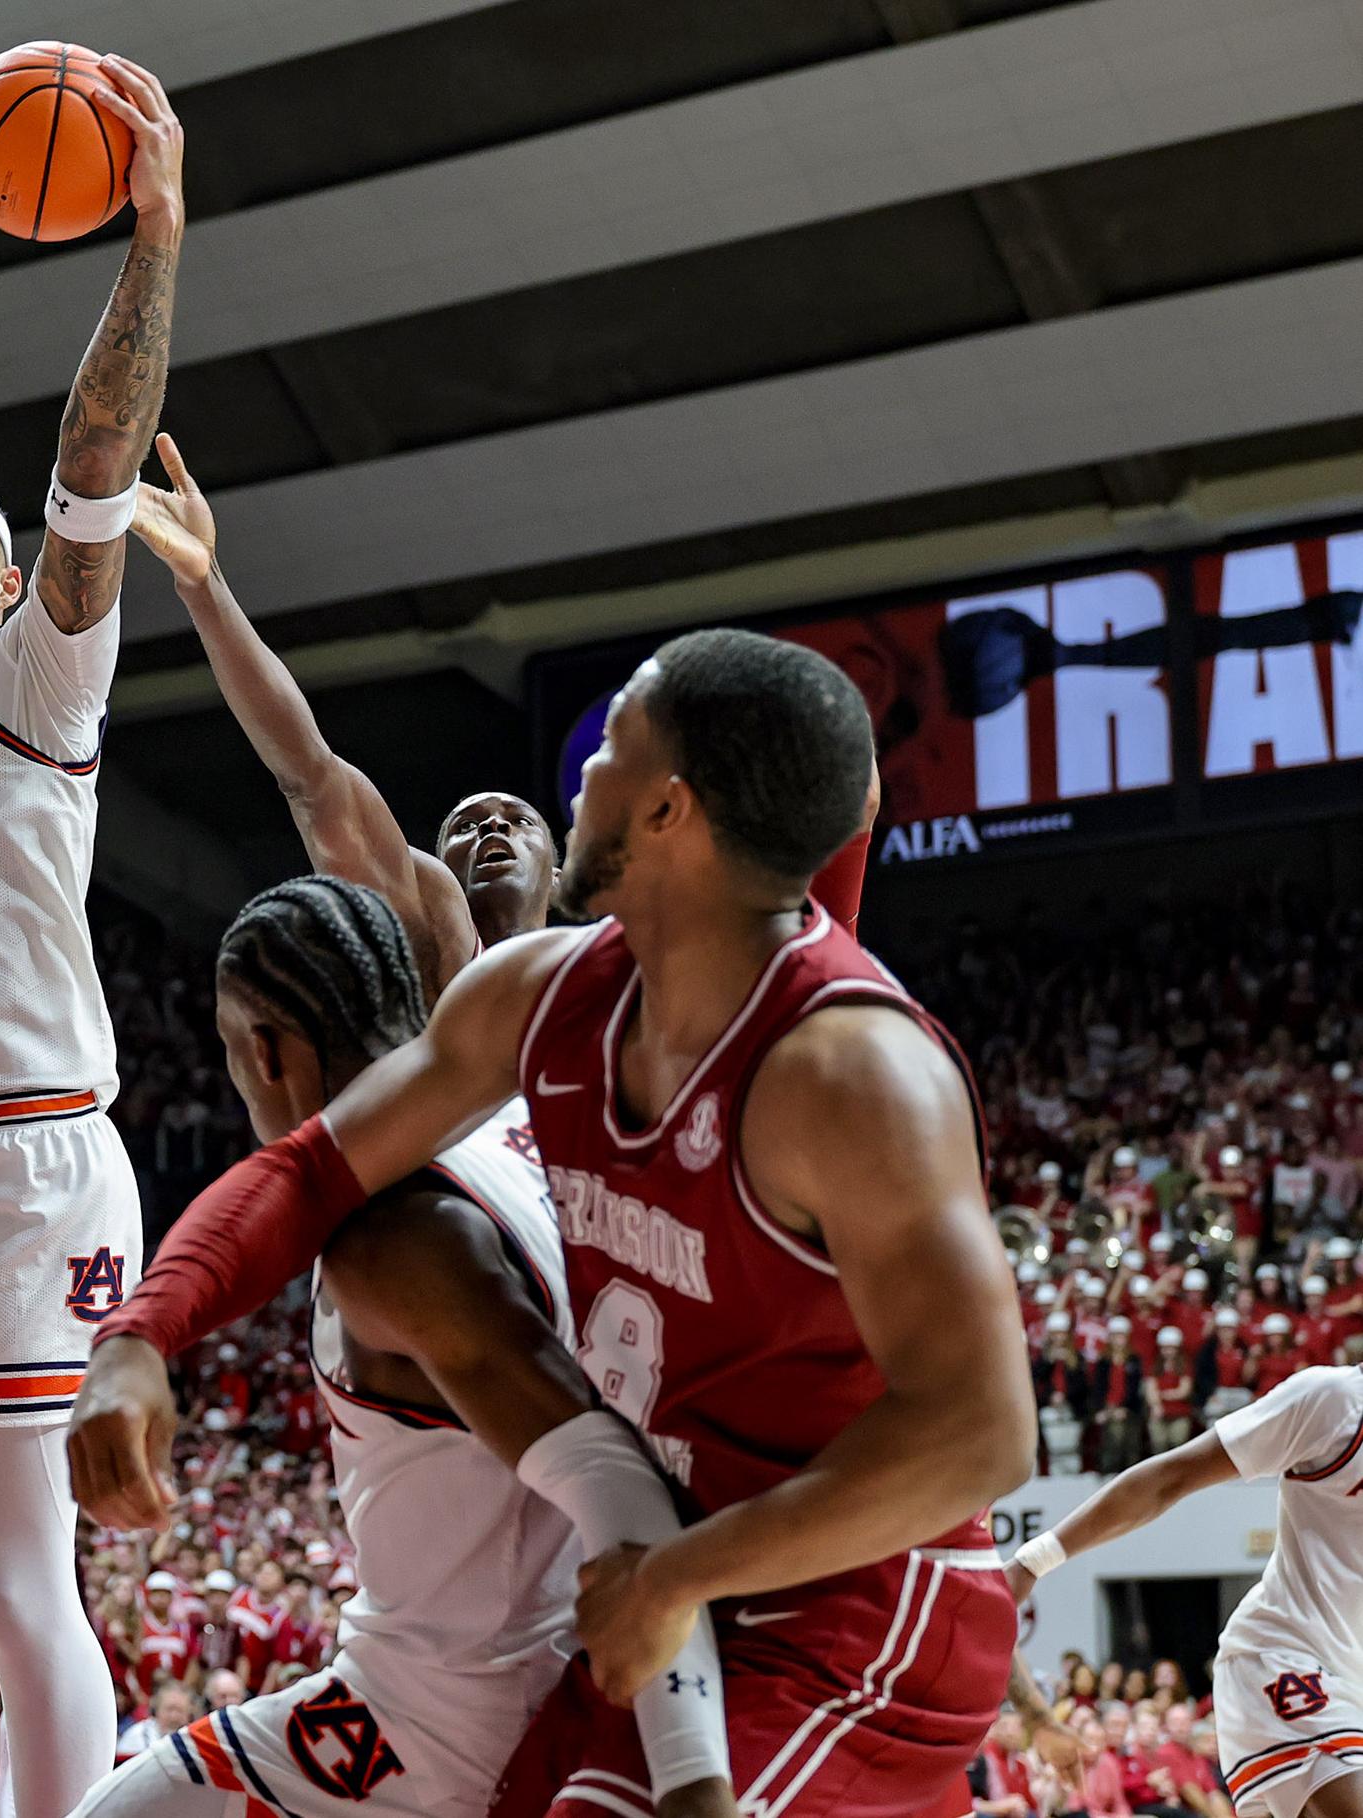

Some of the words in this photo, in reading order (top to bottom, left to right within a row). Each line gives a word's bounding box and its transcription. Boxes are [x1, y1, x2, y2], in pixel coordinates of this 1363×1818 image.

[879, 814, 981, 864] ALFA
[575, 1277, 664, 1430] 8
[285, 1677, 407, 1802] AU
